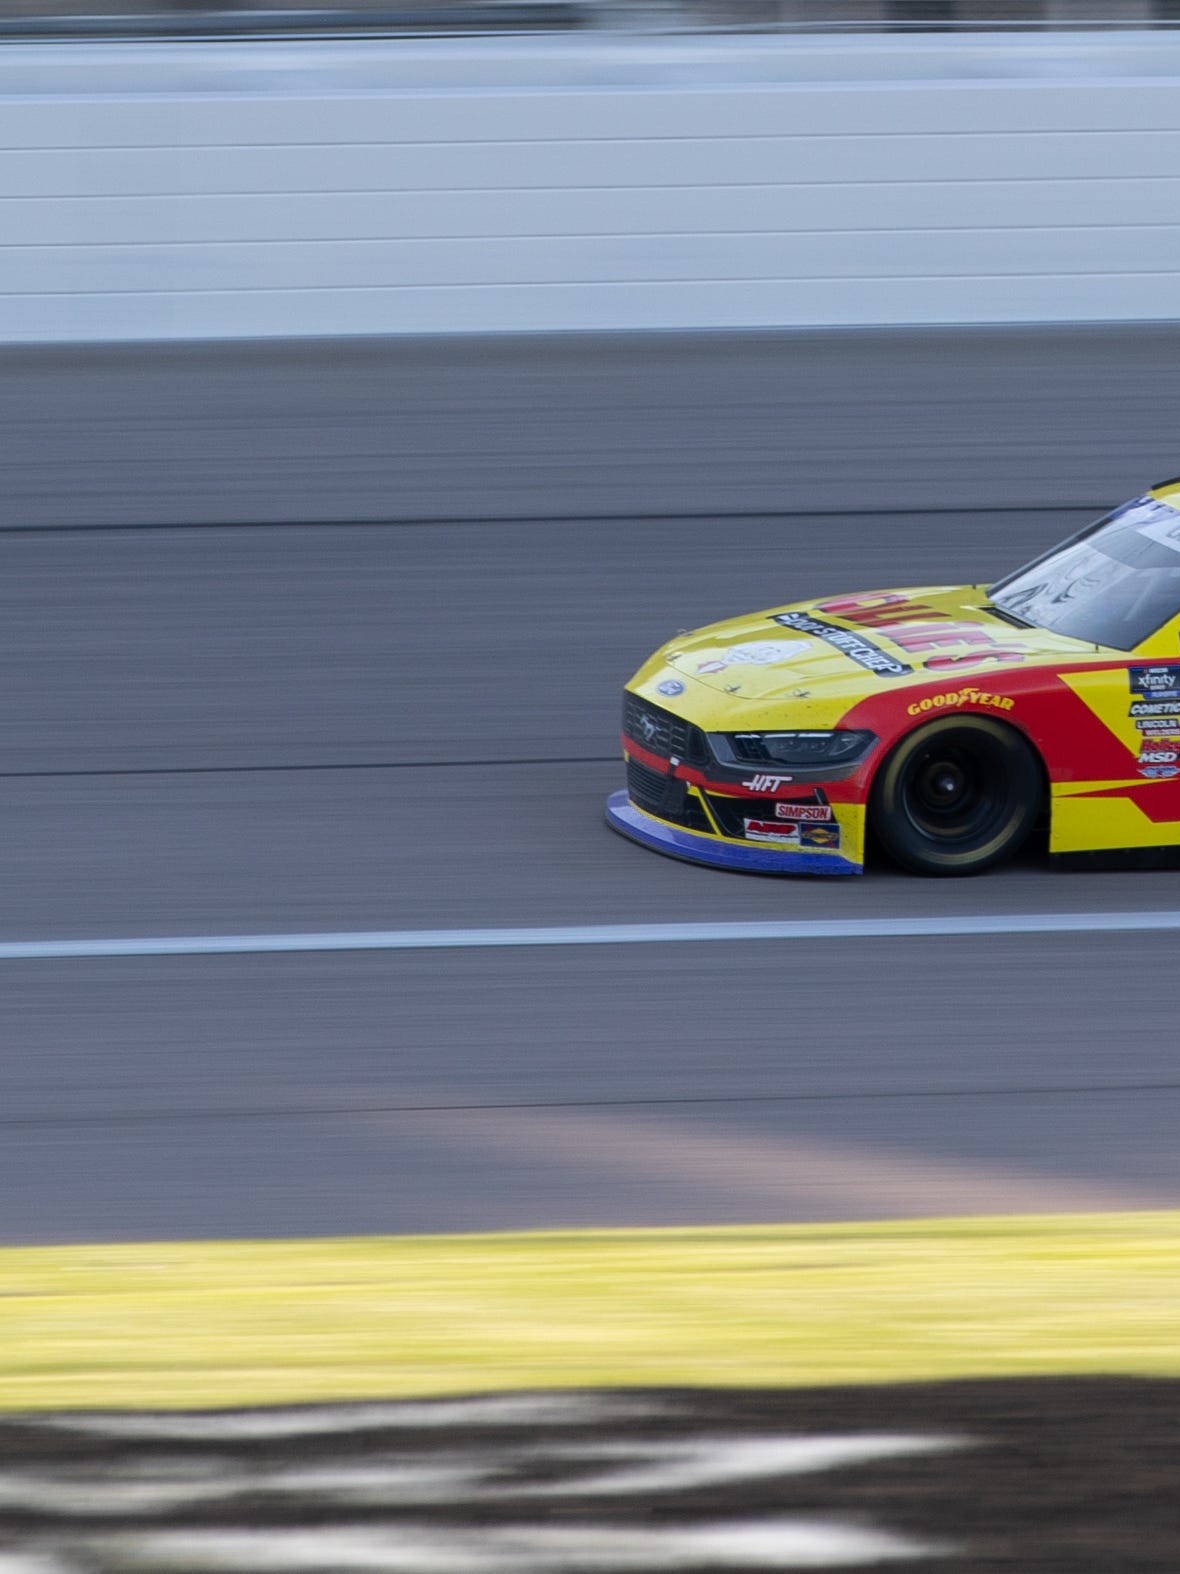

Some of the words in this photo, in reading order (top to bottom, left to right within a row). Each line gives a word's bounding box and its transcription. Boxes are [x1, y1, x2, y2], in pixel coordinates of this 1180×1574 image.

[814, 623, 867, 652] STUFF
[850, 646, 904, 674] CHEAP
[1138, 673, 1176, 688] xfinity
[907, 687, 1015, 715] GOODYEAR
[1137, 720, 1177, 729] LINCOLN
[1138, 752, 1178, 763] MSD
[741, 774, 793, 792] HFT
[777, 805, 828, 819] SIMPSON
